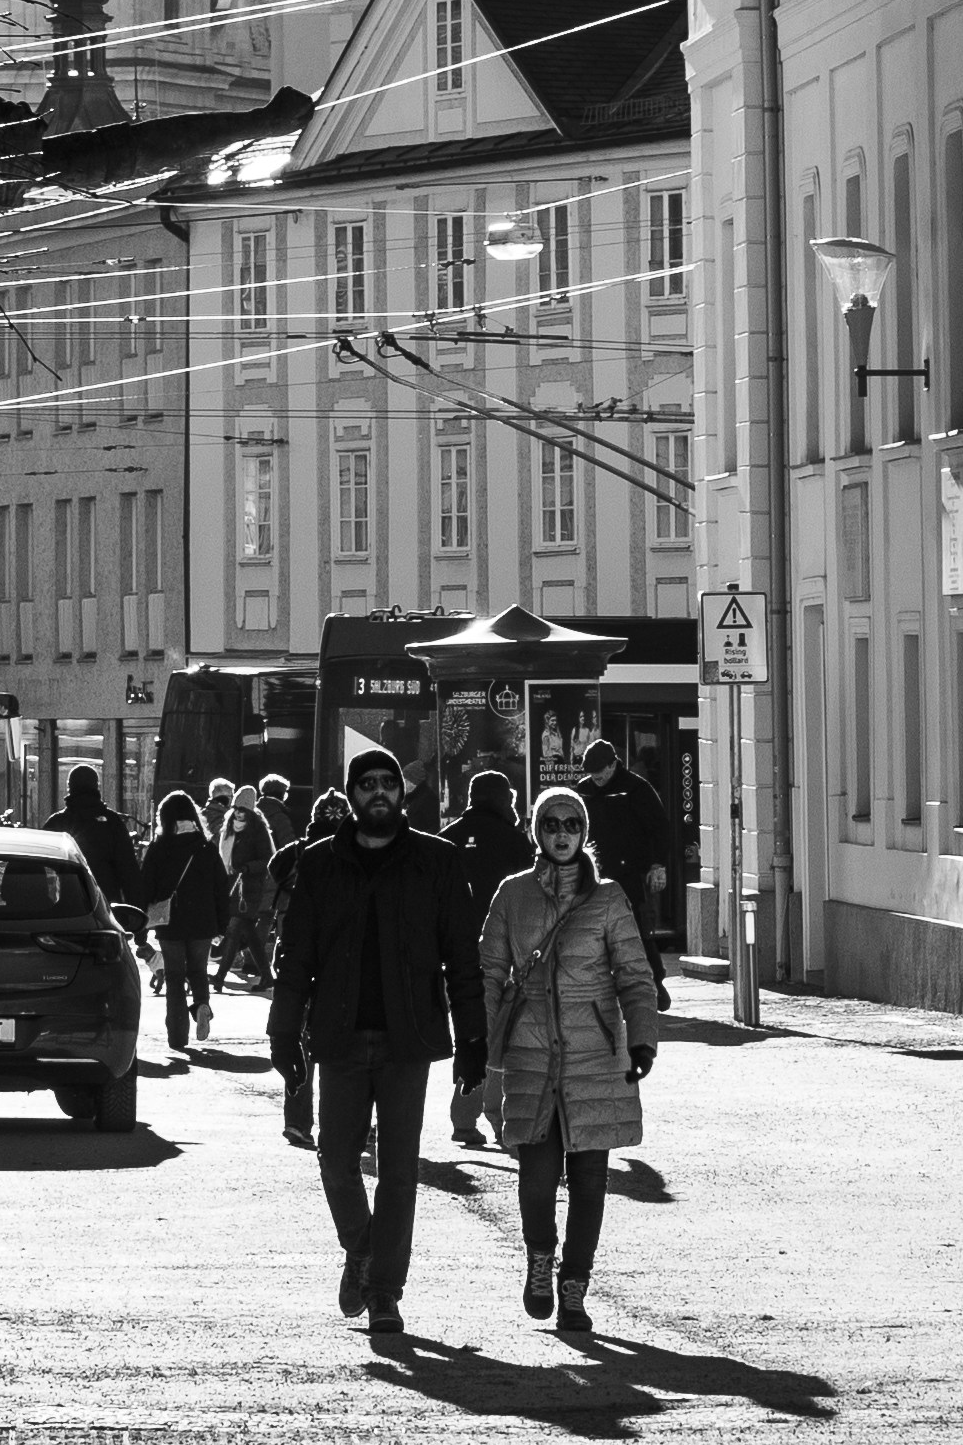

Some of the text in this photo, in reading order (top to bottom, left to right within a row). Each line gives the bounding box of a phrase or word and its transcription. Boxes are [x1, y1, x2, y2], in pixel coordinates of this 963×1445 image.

[724, 648, 747, 657] Rising
[723, 657, 749, 665] bollard
[358, 678, 365, 694] 3
[370, 679, 405, 694] SALZBURG
[540, 772, 556, 781] DER
